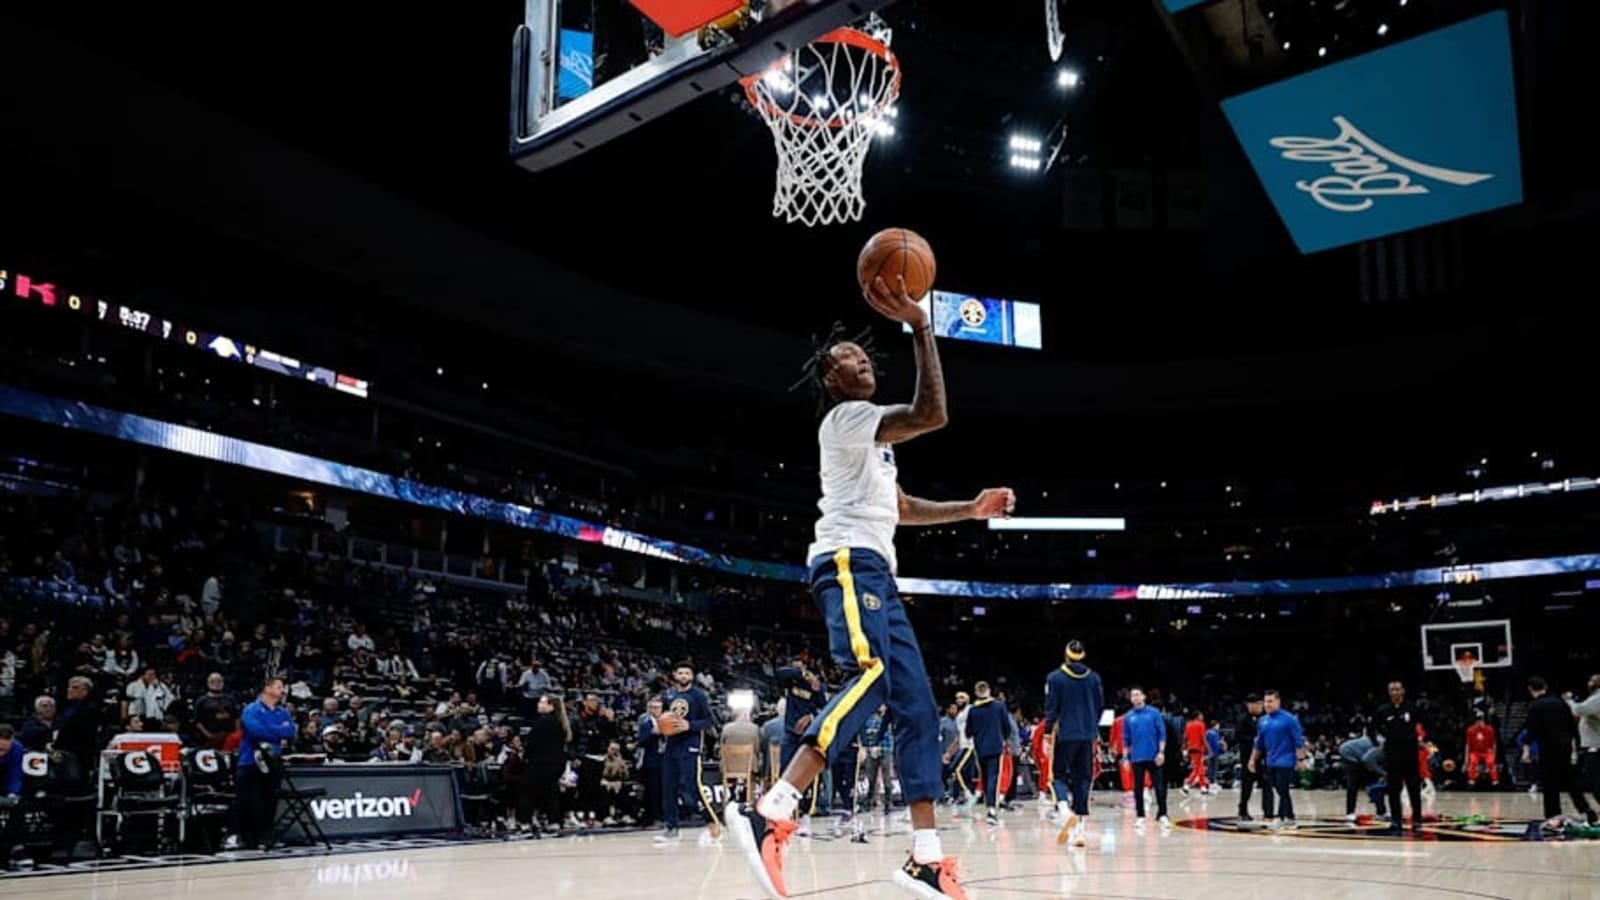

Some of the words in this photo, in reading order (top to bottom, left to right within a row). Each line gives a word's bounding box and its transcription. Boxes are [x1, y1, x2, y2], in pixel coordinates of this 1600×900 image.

[1268, 115, 1495, 212] Ball
[22, 751, 49, 777] G
[124, 750, 152, 775] G
[195, 749, 220, 773] G
[310, 791, 412, 820] verizon
